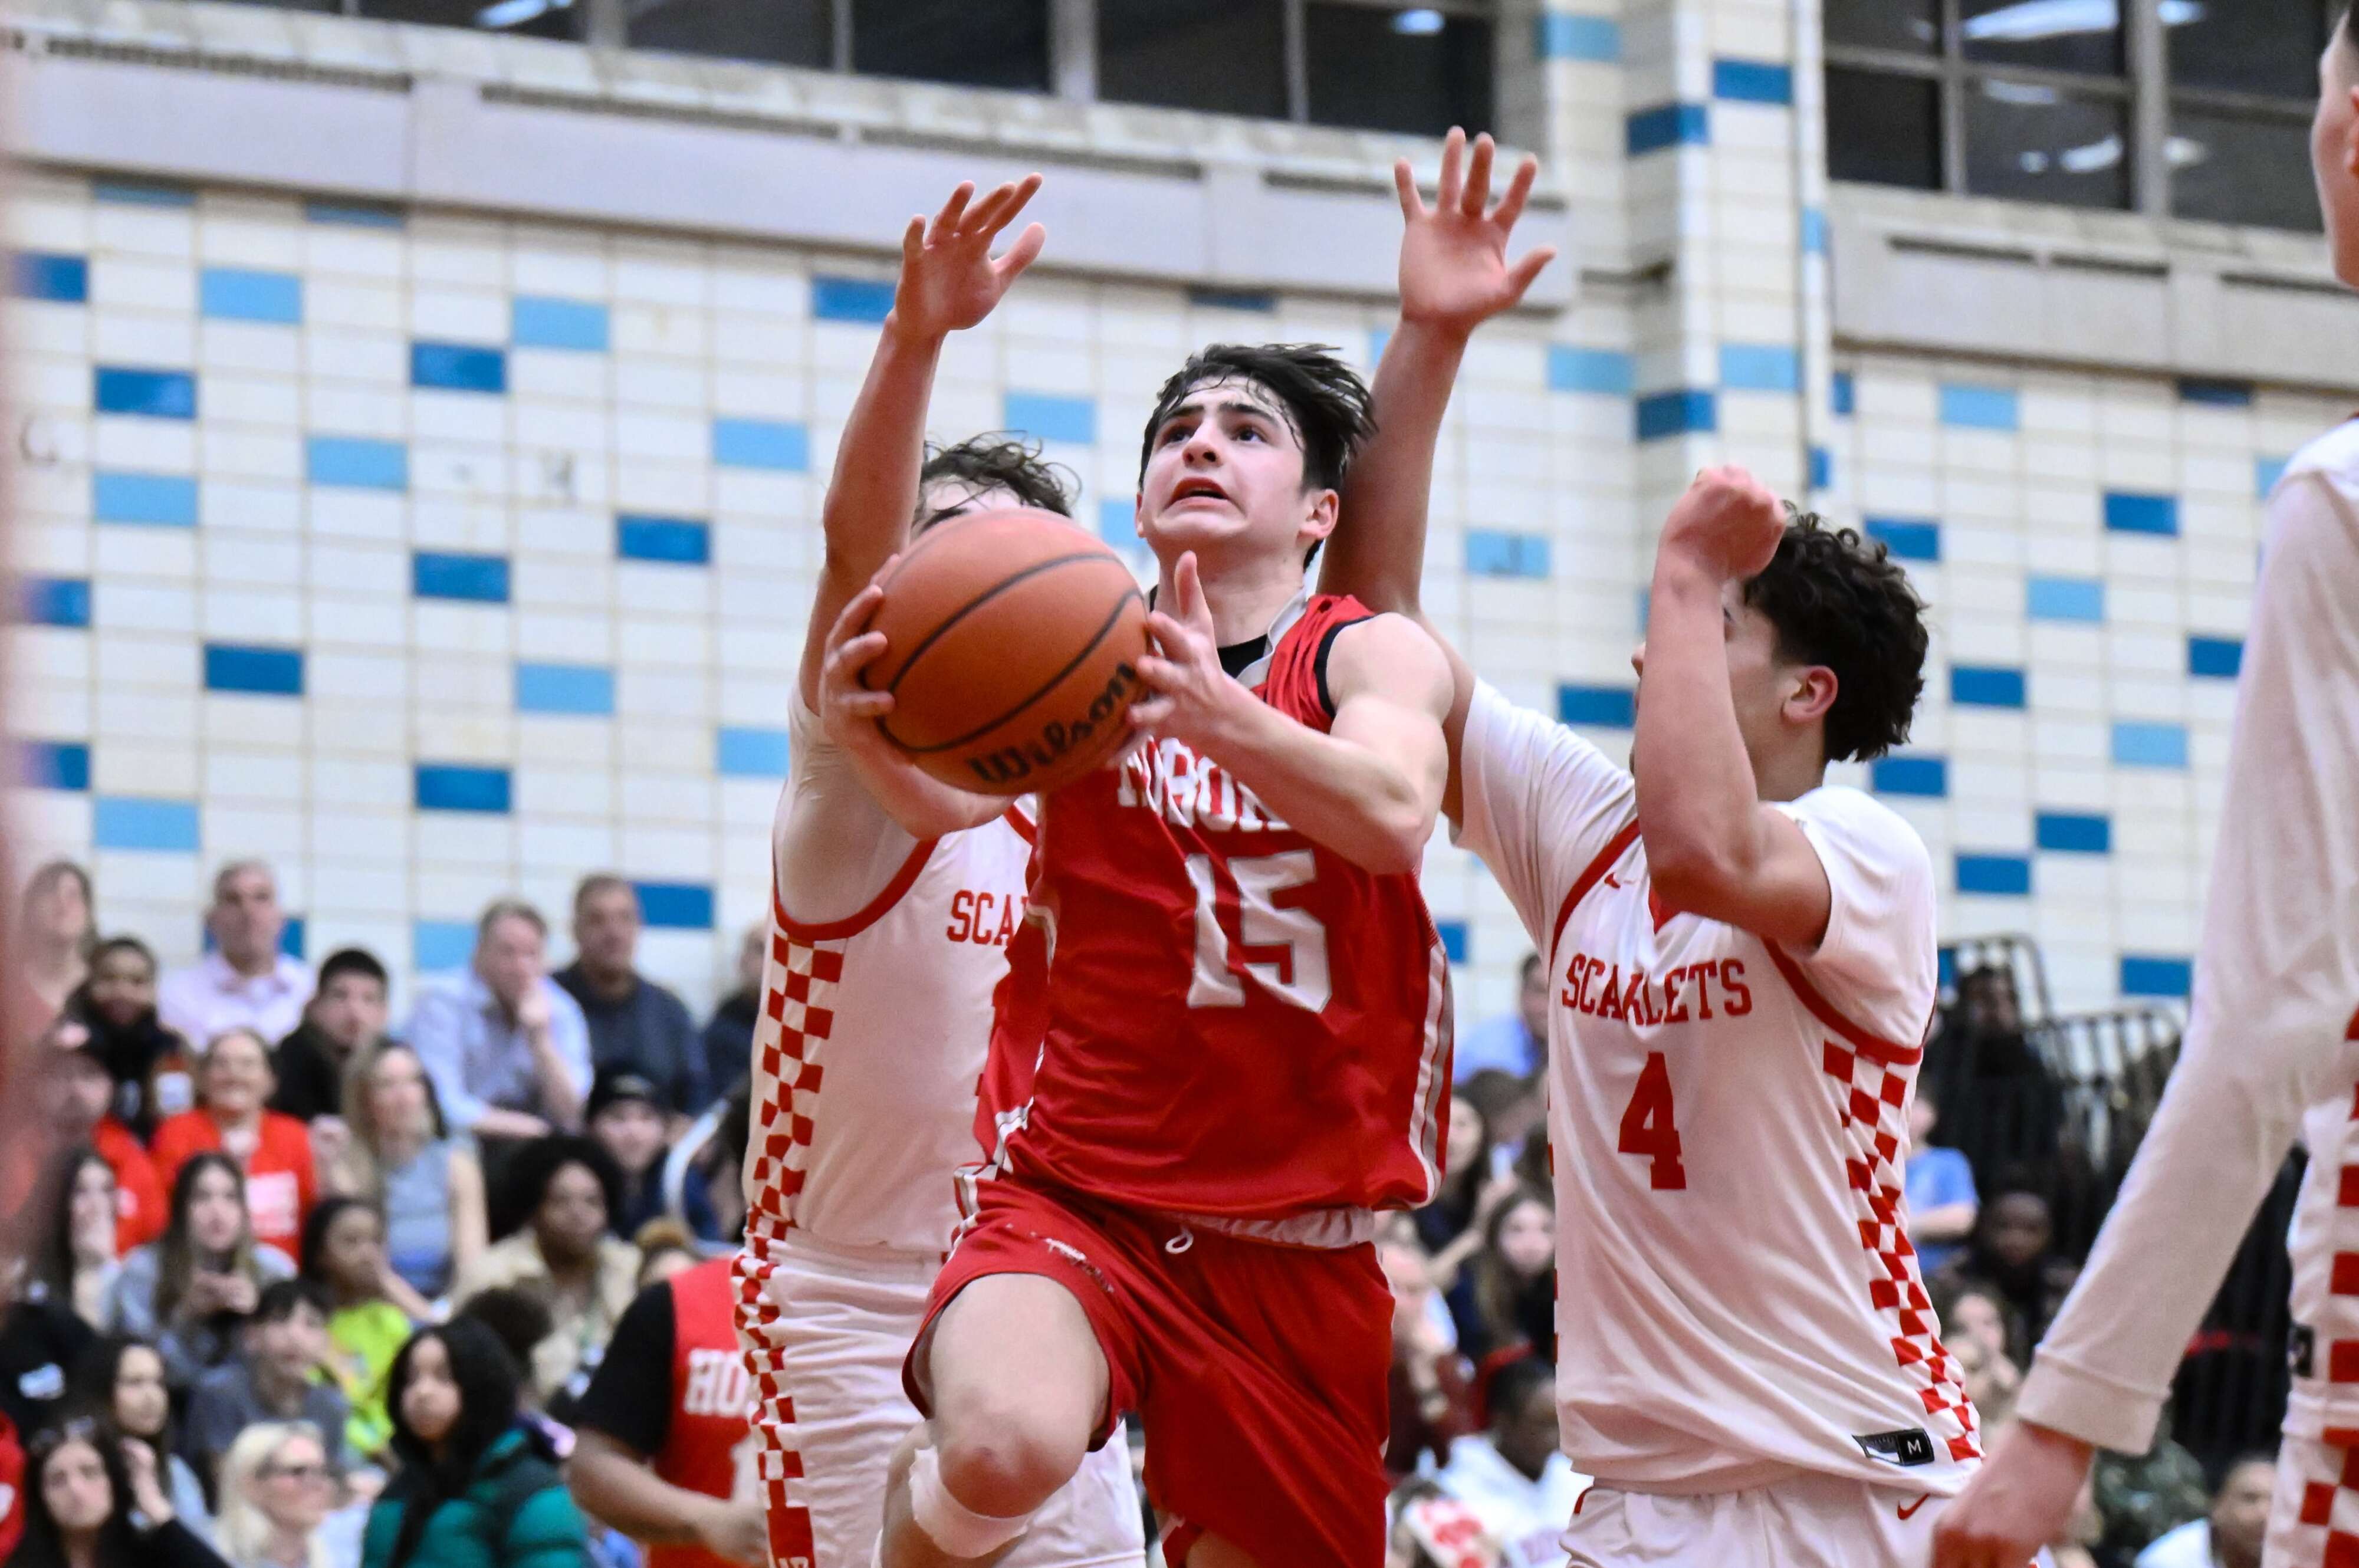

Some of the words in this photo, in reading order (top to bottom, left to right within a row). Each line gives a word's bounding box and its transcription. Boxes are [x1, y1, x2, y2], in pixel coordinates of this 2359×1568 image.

[967, 662, 1136, 783] Wilson
[947, 889, 1029, 946] SCA
[1185, 848, 1332, 1013] 15
[1562, 953, 1752, 1026] SCARLETS
[1618, 1052, 1687, 1190] 4
[685, 1349, 749, 1418] HO
[1907, 1438, 1922, 1455] M
